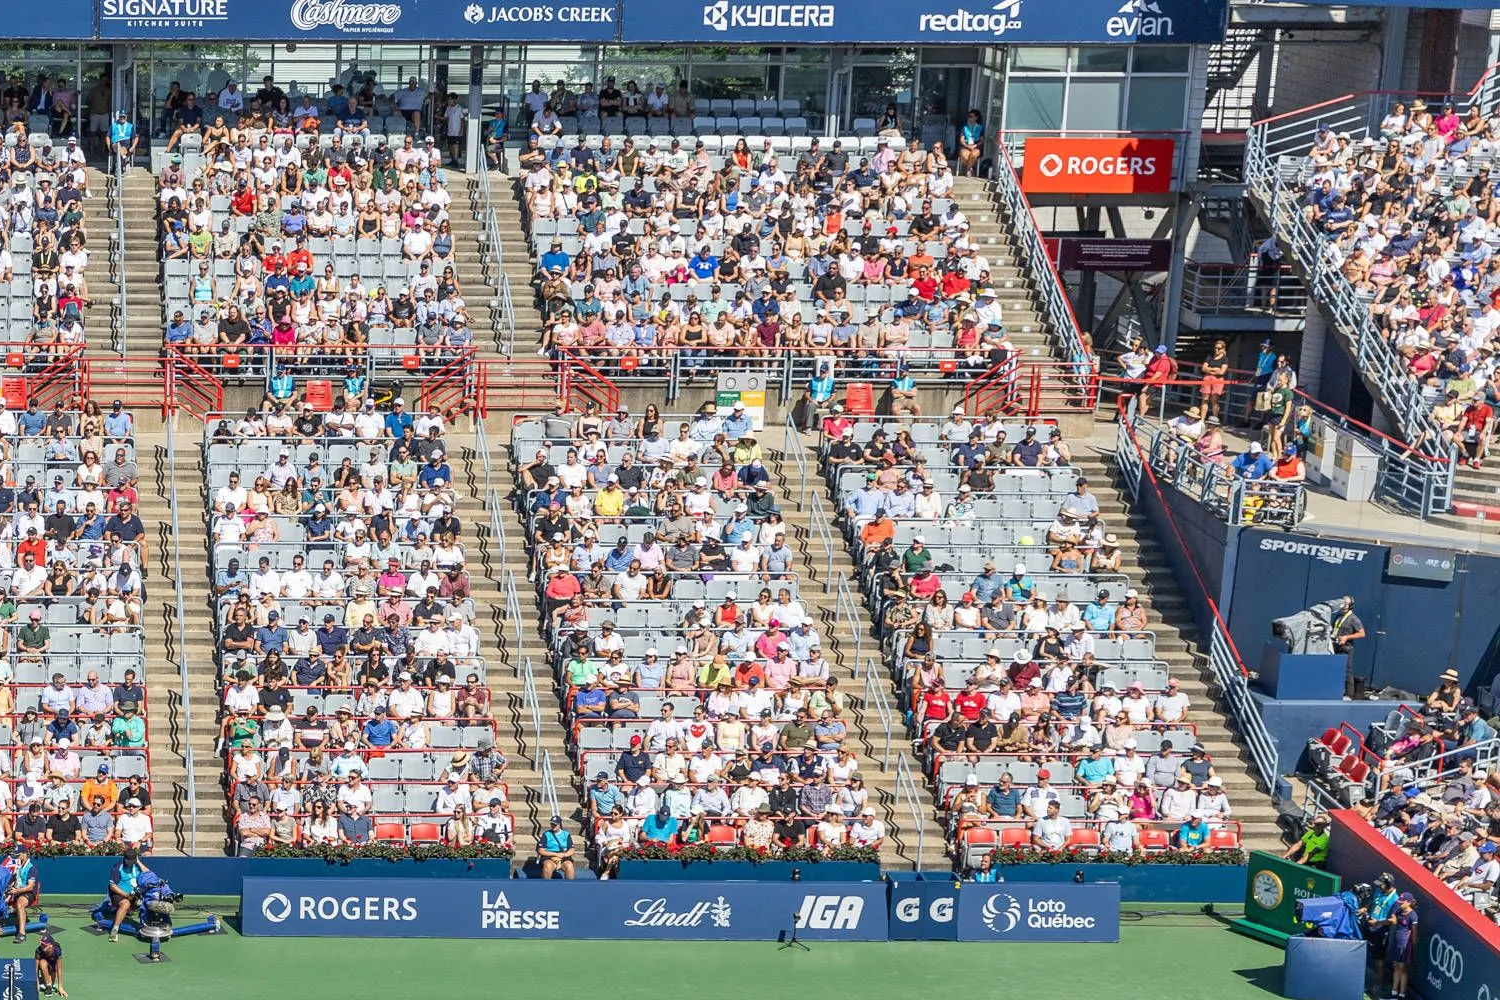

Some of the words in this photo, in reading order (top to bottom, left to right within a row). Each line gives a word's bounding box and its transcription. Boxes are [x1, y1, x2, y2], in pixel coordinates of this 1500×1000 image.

[103, 0, 228, 15] SIGNATURE
[290, 0, 401, 30] Cashmere
[488, 6, 553, 22] JACOB'S
[558, 7, 613, 22] CREEK
[731, 5, 834, 27] KYOCERA
[919, 9, 1022, 35] redtag.ca
[1107, 13, 1172, 36] evian
[1066, 156, 1156, 175] ROGERS
[1259, 538, 1368, 562] SPORTSNET
[954, 881, 961, 889] 2
[1293, 887, 1324, 899] ROL
[299, 896, 418, 921] ROGERS
[482, 890, 510, 909] LA
[1028, 898, 1066, 913] Loto
[482, 910, 560, 929] PRESSE
[624, 898, 712, 926] Lindt
[795, 895, 865, 929] IGA
[1028, 913, 1095, 929] Québec
[1427, 971, 1442, 991] Audi
